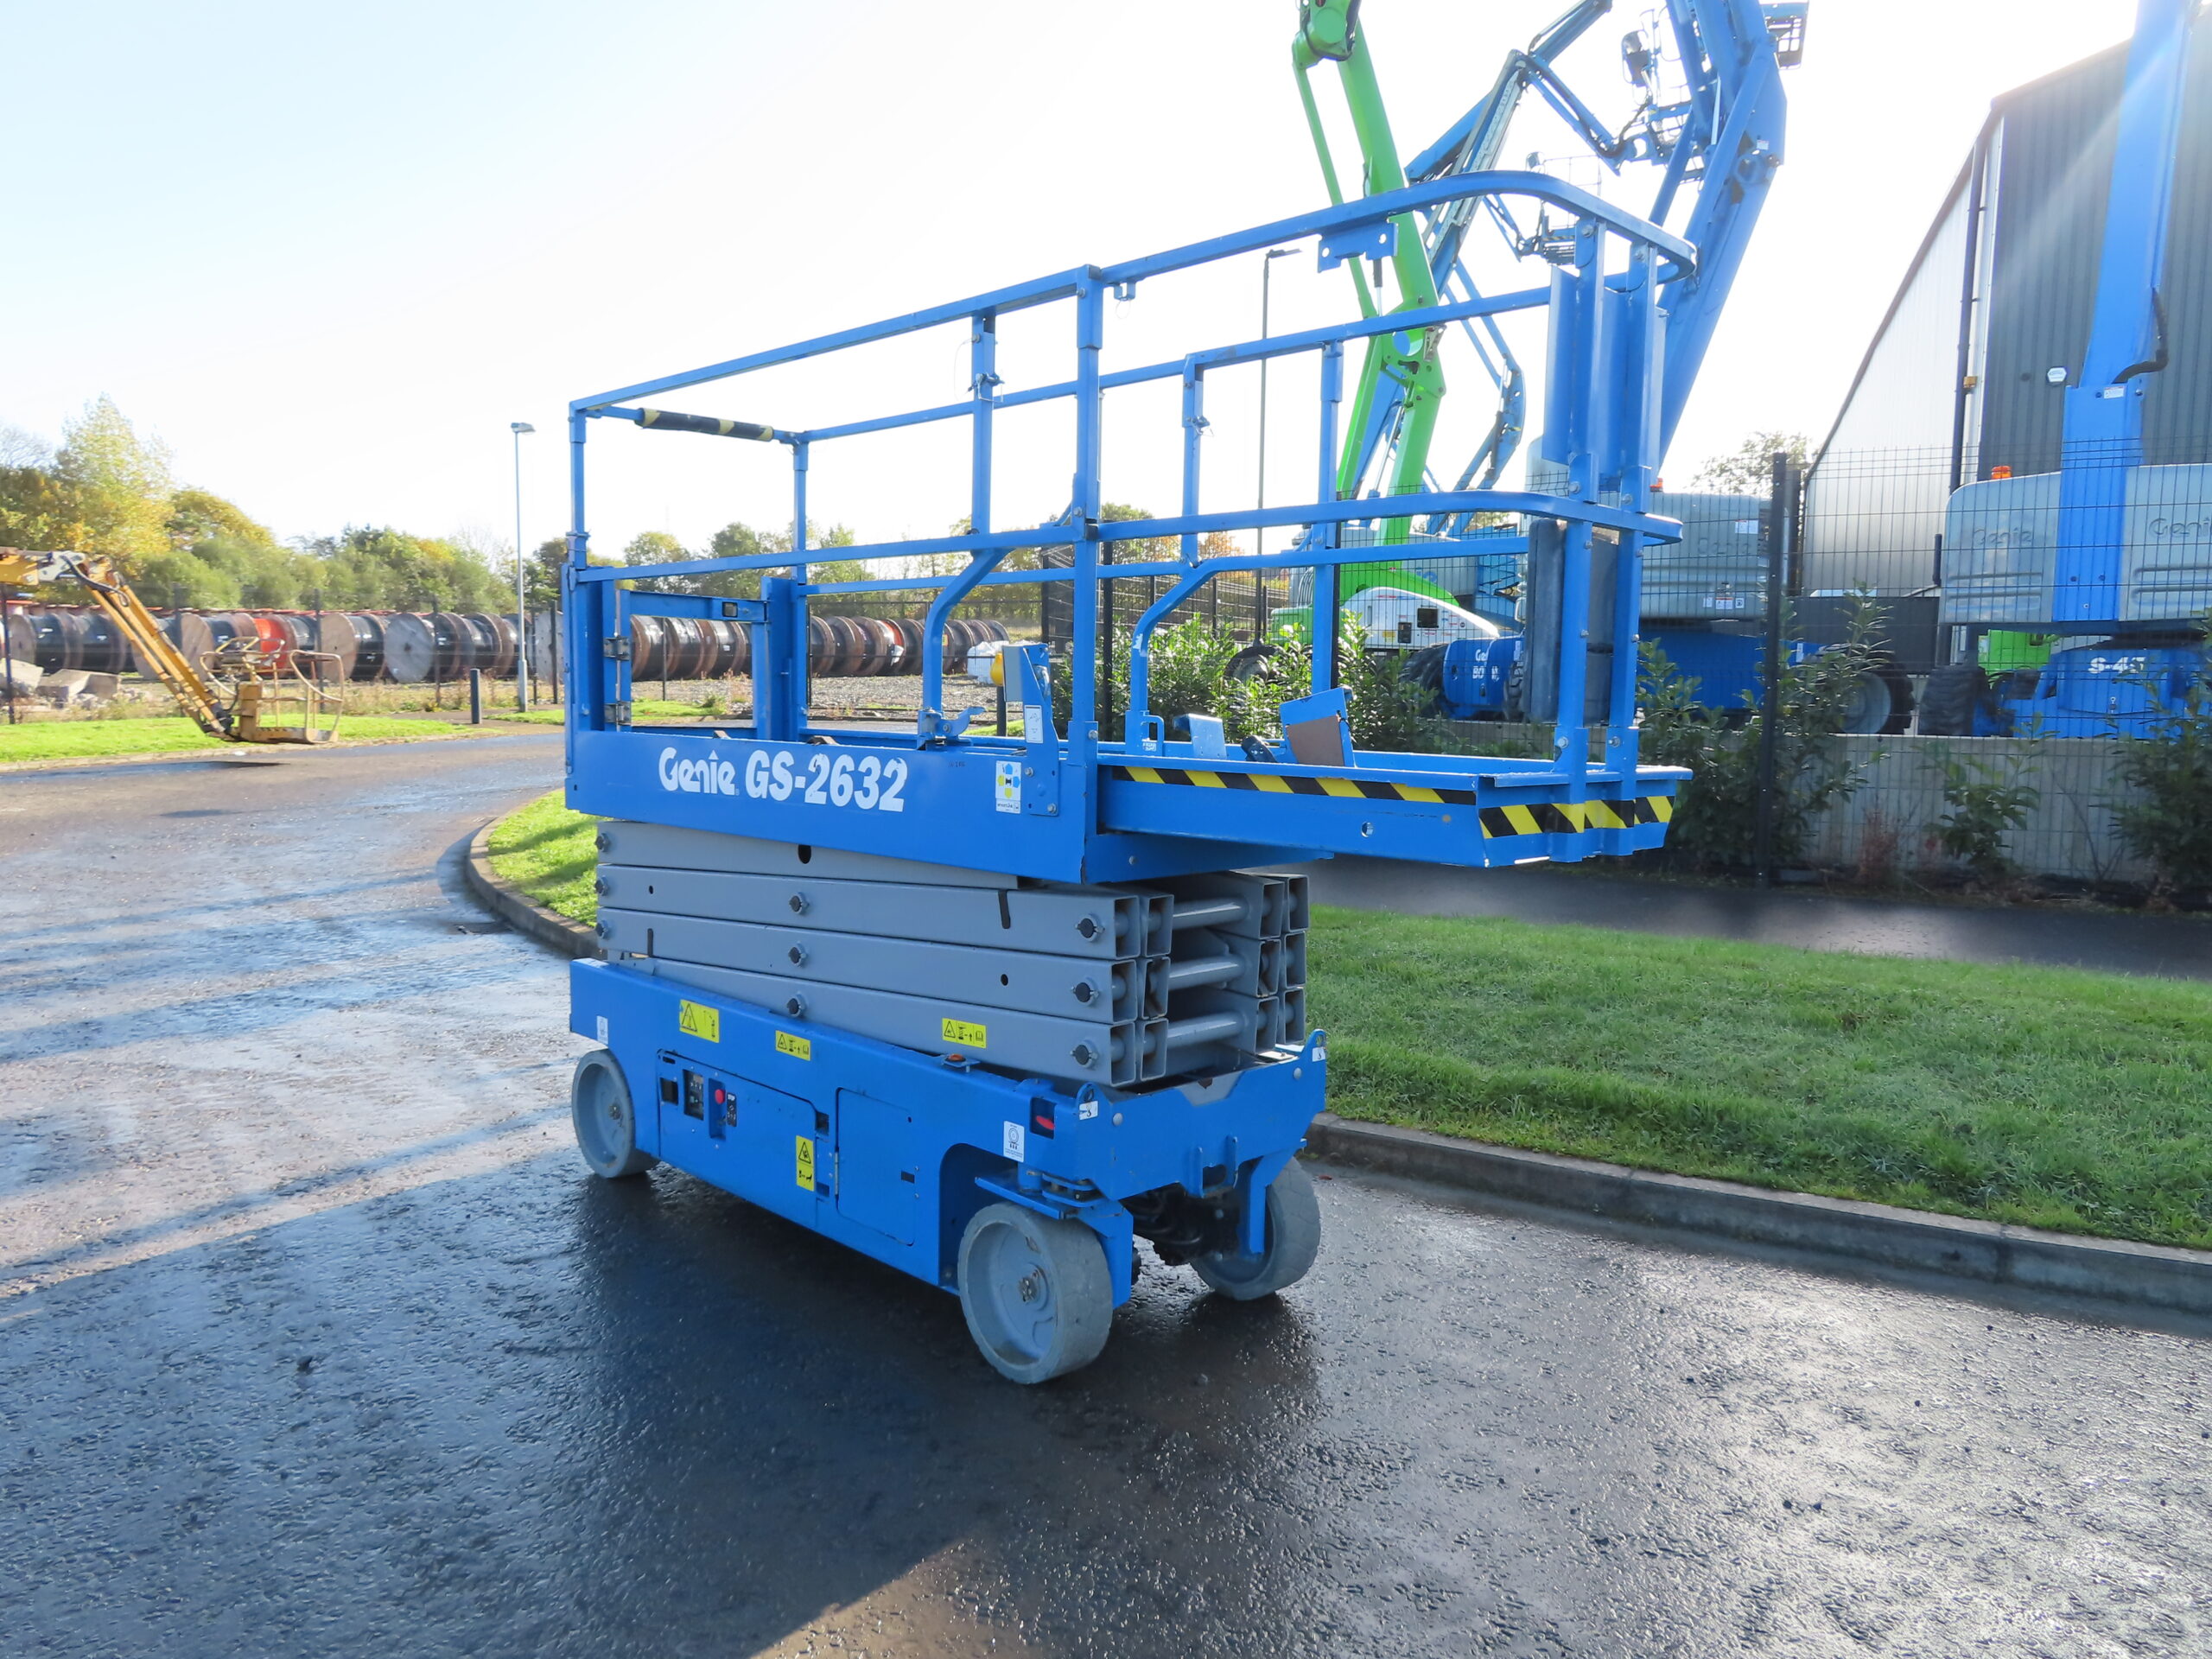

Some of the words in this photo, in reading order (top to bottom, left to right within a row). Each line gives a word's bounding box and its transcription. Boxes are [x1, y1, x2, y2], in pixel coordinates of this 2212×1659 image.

[2148, 517, 2212, 537] Geni
[658, 747, 736, 796] Genie
[745, 749, 908, 812] GS-2632
